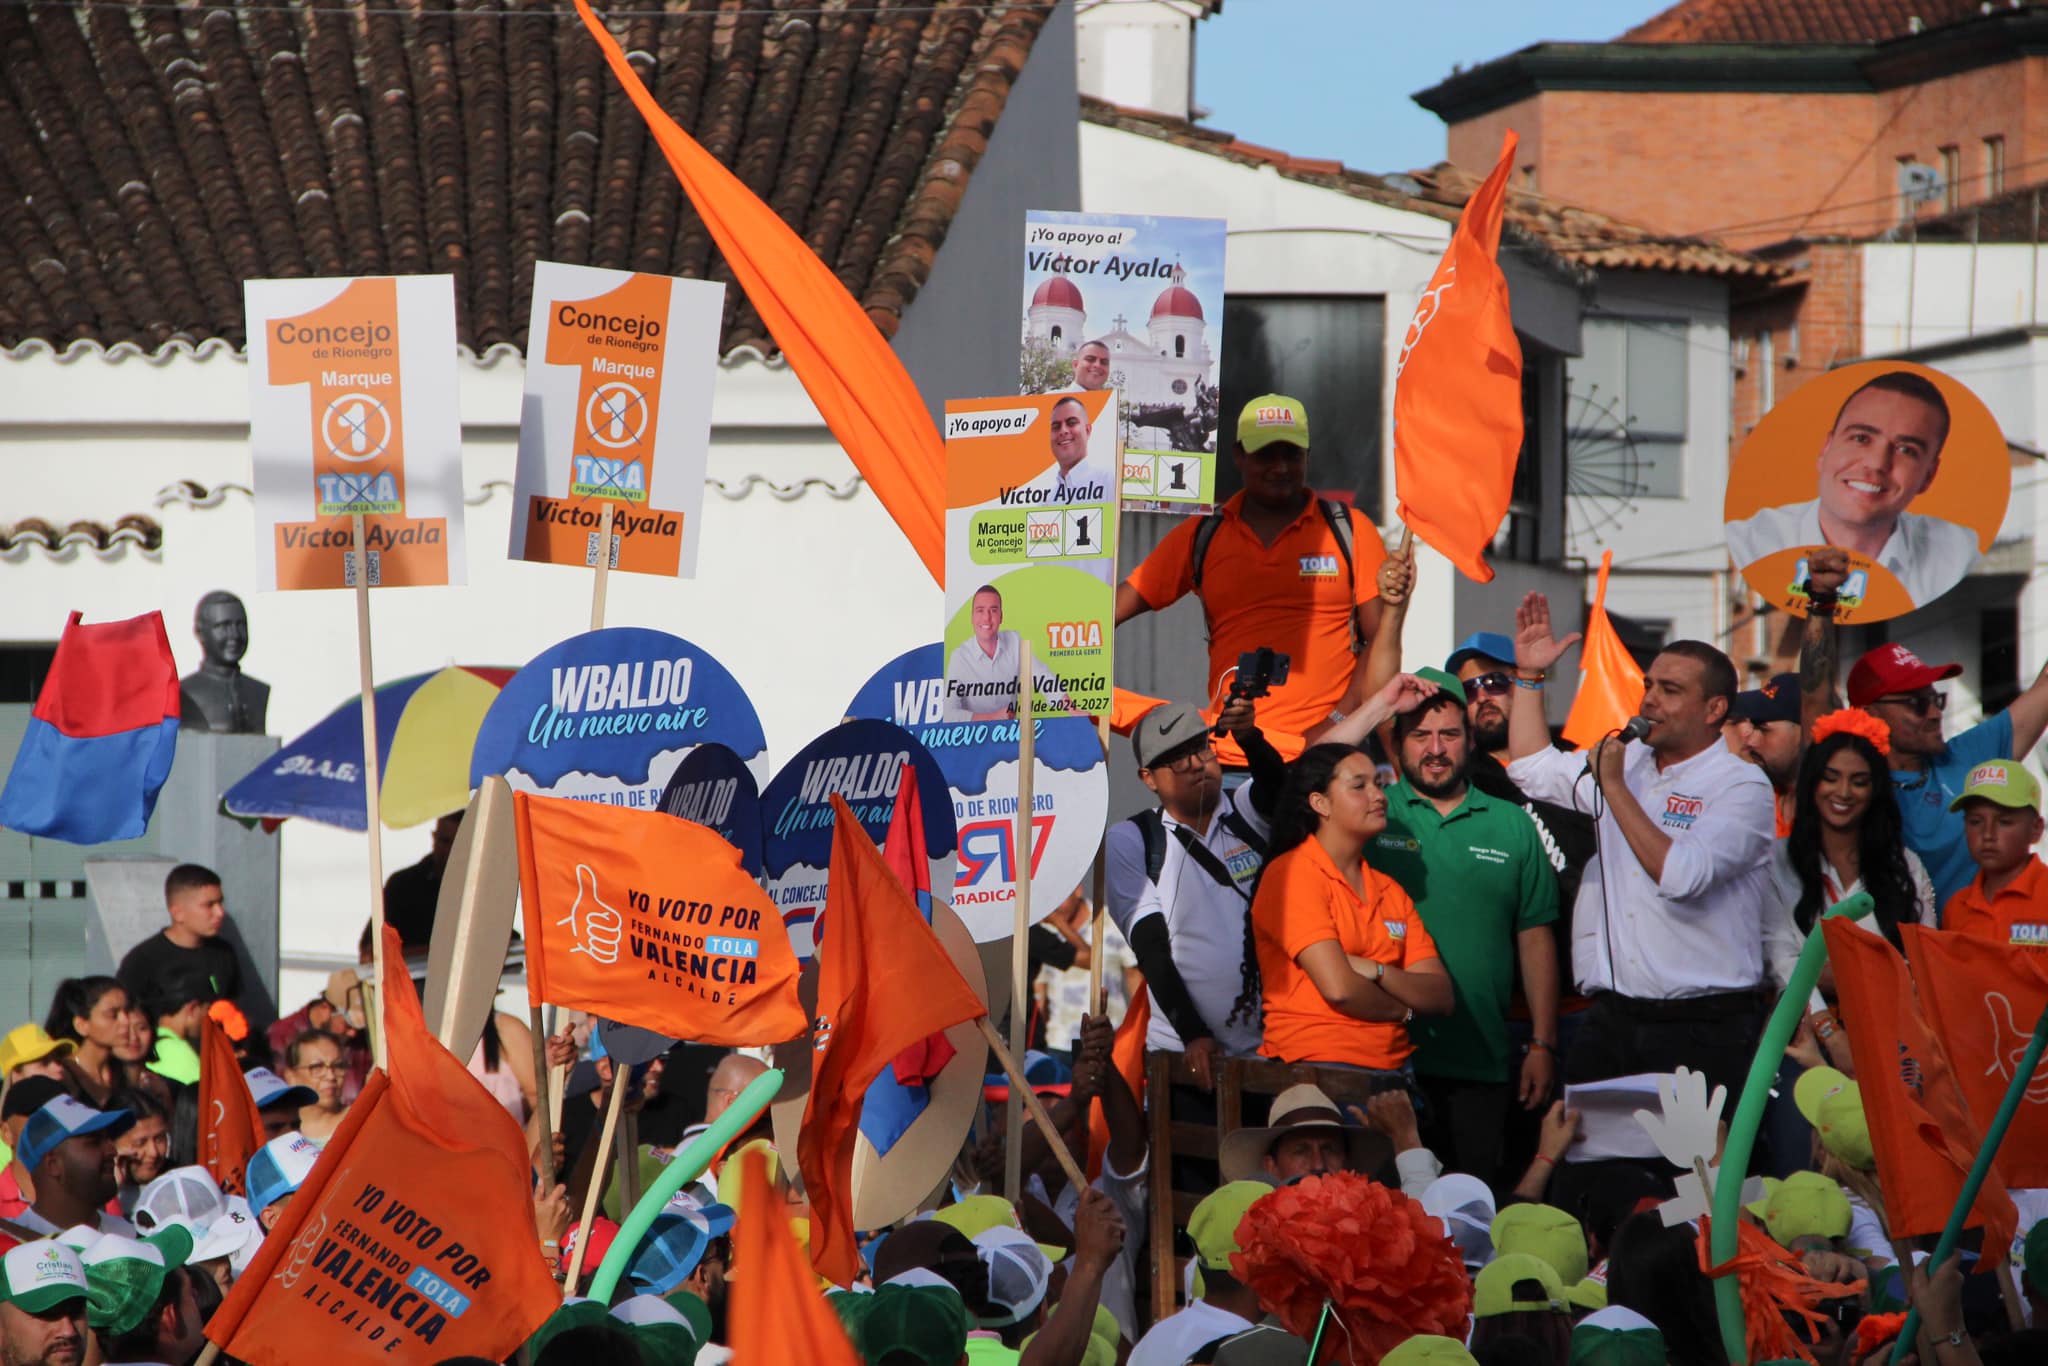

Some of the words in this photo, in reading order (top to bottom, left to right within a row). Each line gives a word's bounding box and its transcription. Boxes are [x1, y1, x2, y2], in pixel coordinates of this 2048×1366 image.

[1031, 228, 1054, 243] ¡Yo
[1057, 232, 1105, 245] apoyo
[1107, 232, 1122, 245] a!
[1028, 251, 1100, 275] Víctor
[1104, 255, 1174, 282] Ayala
[277, 321, 391, 347] Concejo
[558, 305, 661, 341] Concejo
[312, 347, 329, 359] de
[332, 346, 393, 360] Rionegro
[587, 334, 602, 346] de
[605, 336, 659, 353] Rionegro
[322, 371, 392, 389] Marque
[592, 357, 656, 379] Marque
[337, 402, 366, 452] 1
[601, 391, 627, 440] 1
[950, 419, 969, 435] ¡Yo
[971, 418, 1011, 433] apoyo
[1014, 414, 1027, 428] a!
[1258, 407, 1292, 421] TOLA
[577, 459, 642, 489] TOLA
[1170, 462, 1186, 490] 1
[320, 476, 395, 501] TOLA
[1000, 486, 1051, 505] Víctor
[1054, 481, 1104, 504] Ayala
[613, 509, 678, 538] Ayala
[978, 522, 1025, 536] Marque
[1076, 515, 1091, 546] 1
[366, 523, 440, 553] Ayala
[976, 539, 985, 548] Al
[987, 536, 1022, 548] Concejo
[1299, 556, 1337, 570] TOLA
[1048, 622, 1101, 648] TOLA
[552, 657, 693, 713] WBALDO
[1033, 672, 1105, 693] Valencia
[1049, 697, 1110, 712] 2024-2027
[528, 703, 576, 749] Un
[579, 711, 652, 739] nuevo
[655, 705, 709, 731] aire
[920, 724, 988, 749] nuevo
[800, 750, 910, 805] WBALDO
[1972, 767, 2006, 782] TOLA
[629, 790, 646, 807] DE
[968, 800, 985, 817] DE
[774, 796, 809, 840] Un
[628, 889, 649, 913] YO
[658, 898, 712, 925] VOTO
[720, 905, 761, 931] POR
[631, 918, 703, 950] FERNANDO
[711, 938, 753, 956] TOLA
[630, 934, 757, 985] VALENCIA
[648, 969, 735, 1006] ALCALDE
[332, 1219, 411, 1275] FERNANDO
[353, 1183, 385, 1213] YO
[379, 1199, 442, 1251] VOTO
[435, 1242, 491, 1291] POR
[311, 1238, 448, 1346] VALENCIA
[415, 1273, 459, 1314] TOLA
[302, 1284, 402, 1353] ALCALDE
